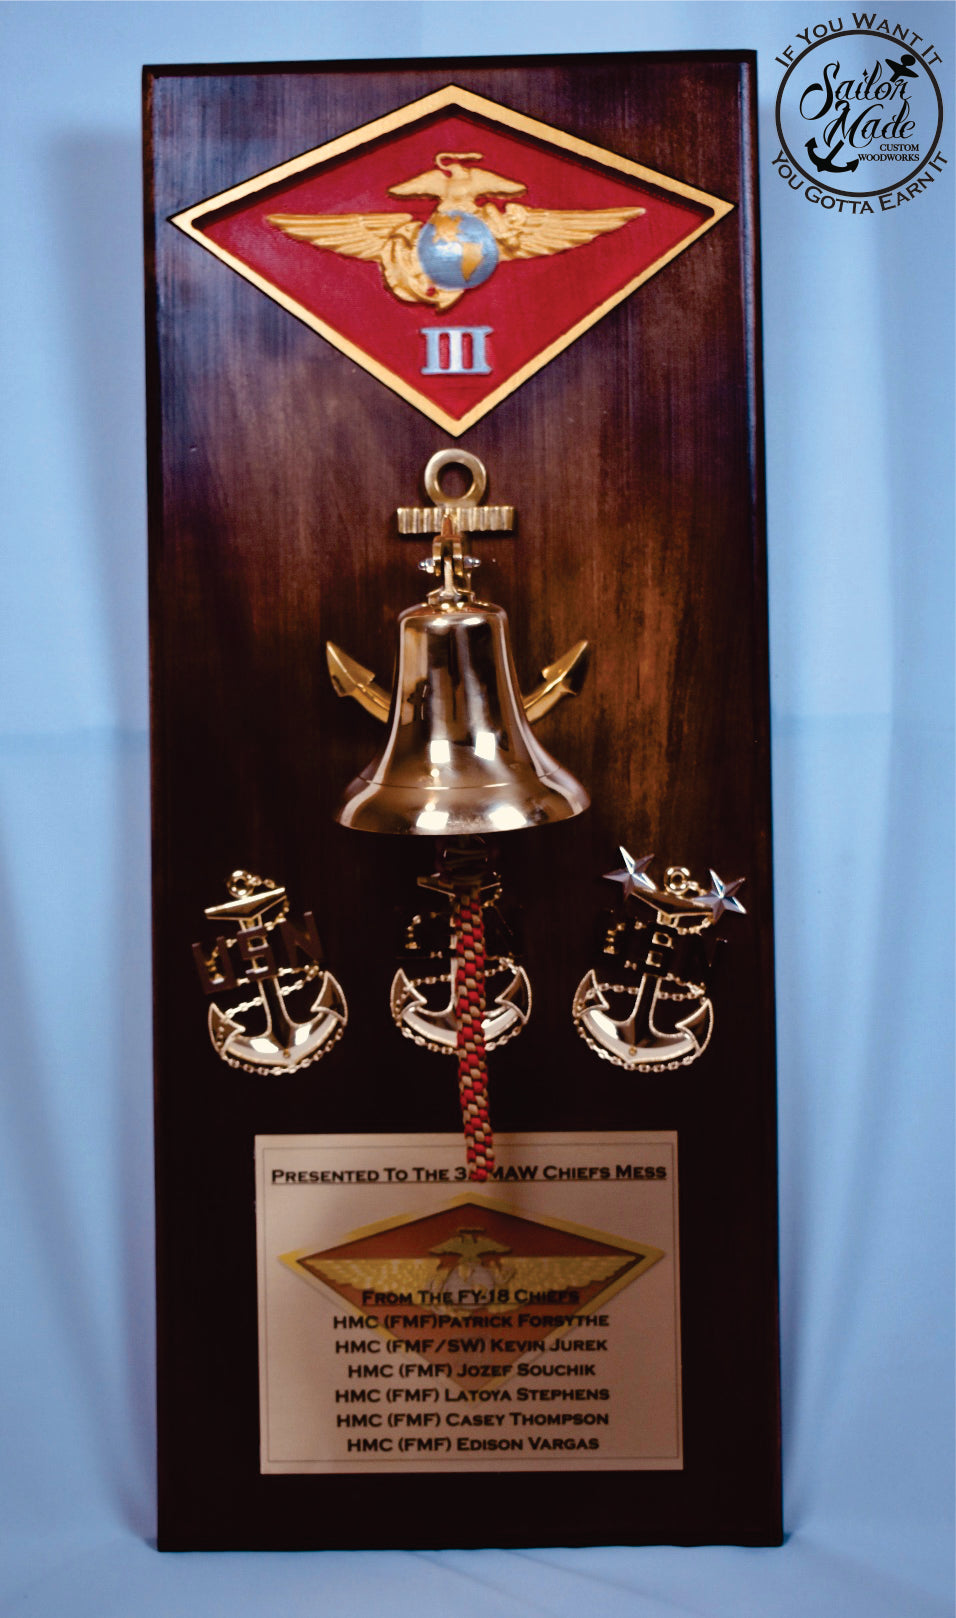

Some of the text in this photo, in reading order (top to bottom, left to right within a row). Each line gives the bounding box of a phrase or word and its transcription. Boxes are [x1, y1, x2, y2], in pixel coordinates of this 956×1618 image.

[271, 1169, 380, 1182] PRESENTED
[383, 1168, 409, 1182] TO
[412, 1167, 449, 1181] THE
[542, 1165, 611, 1180] CHIEFS
[615, 1164, 668, 1180] MESS
[361, 1288, 580, 1305] FROM THE FY-18 CHIEFS
[333, 1316, 378, 1330] HMC
[518, 1313, 609, 1328] FORSYTHE
[335, 1338, 608, 1354] HMC (FMF/SW) KEVIN JUREK
[348, 1363, 596, 1379] HMC (FMF) JOZEF SOUCHIK
[335, 1388, 610, 1403] HMC (FMF) LATOYA STEPHENS
[337, 1412, 609, 1428] HMC (FMF) CASEY THOMPSON
[347, 1437, 599, 1452] HMC (FMF) EDISON VARGAS
